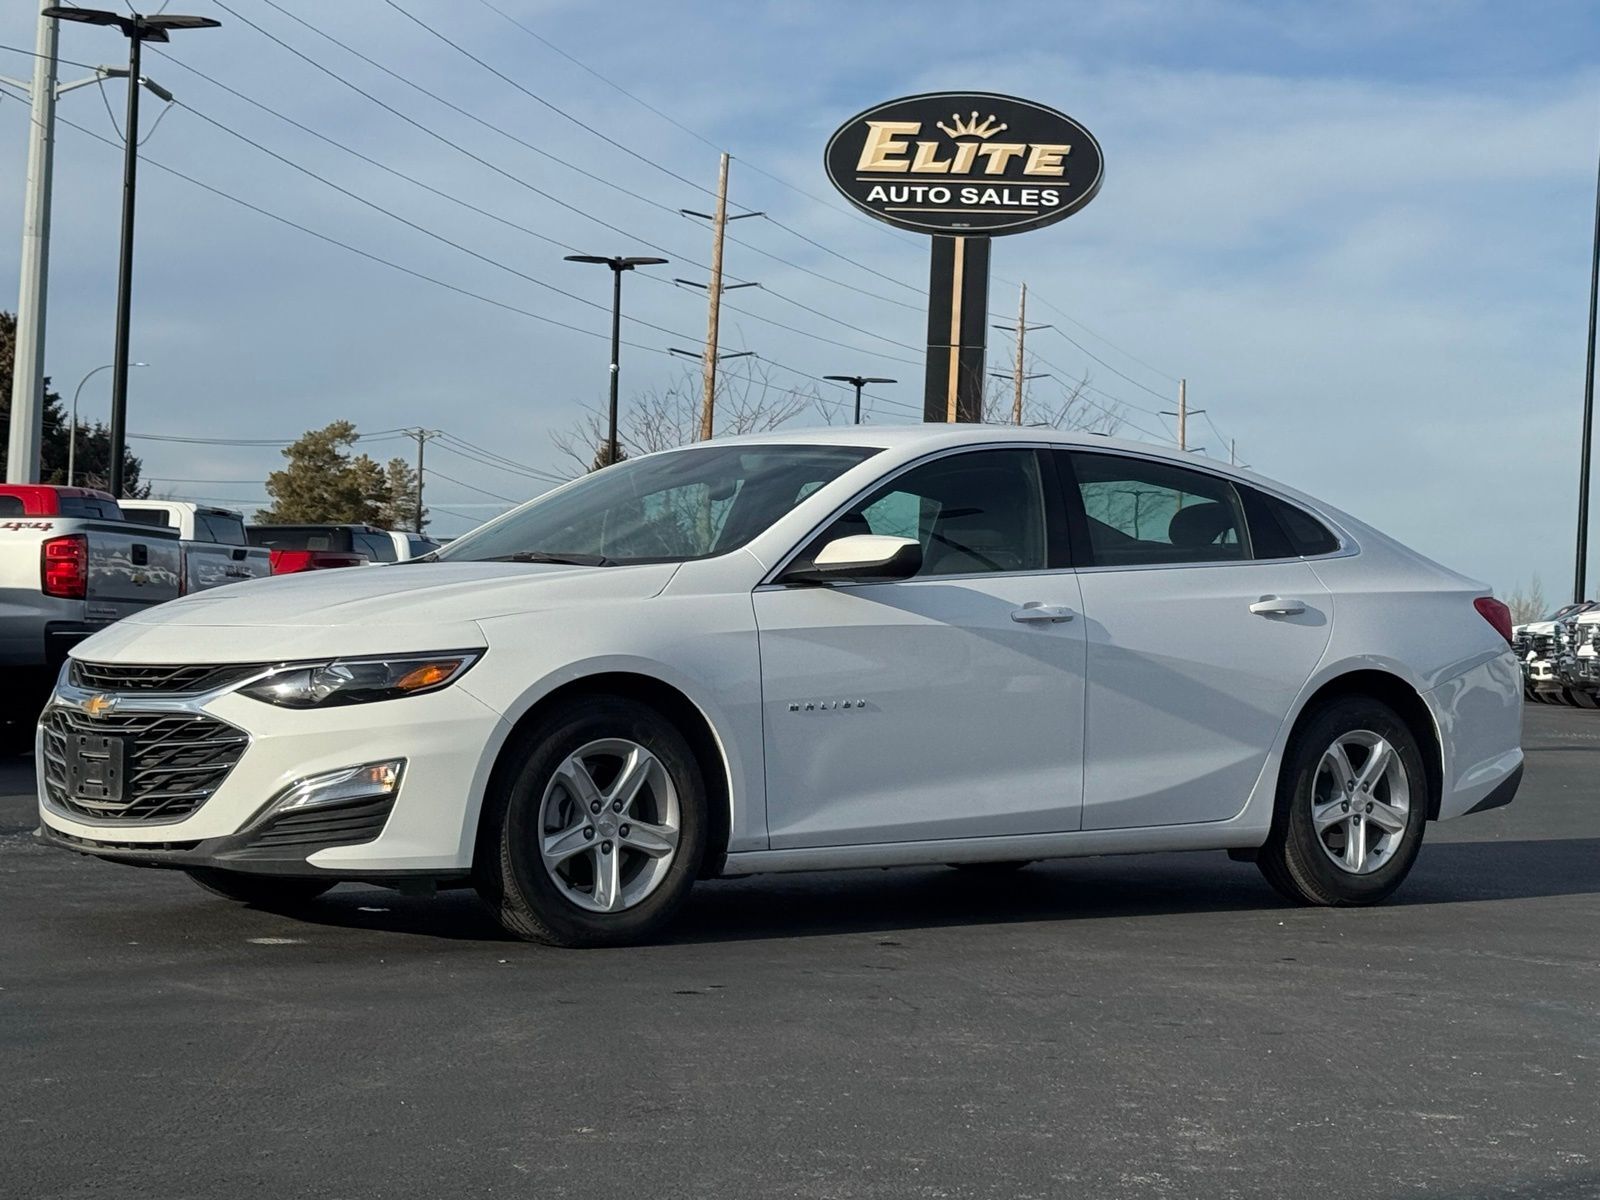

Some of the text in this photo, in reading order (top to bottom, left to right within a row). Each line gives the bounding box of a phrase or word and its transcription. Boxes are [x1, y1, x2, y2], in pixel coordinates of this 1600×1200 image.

[866, 185, 1060, 207] AUTO SALES
[788, 698, 867, 712] MALIBU
